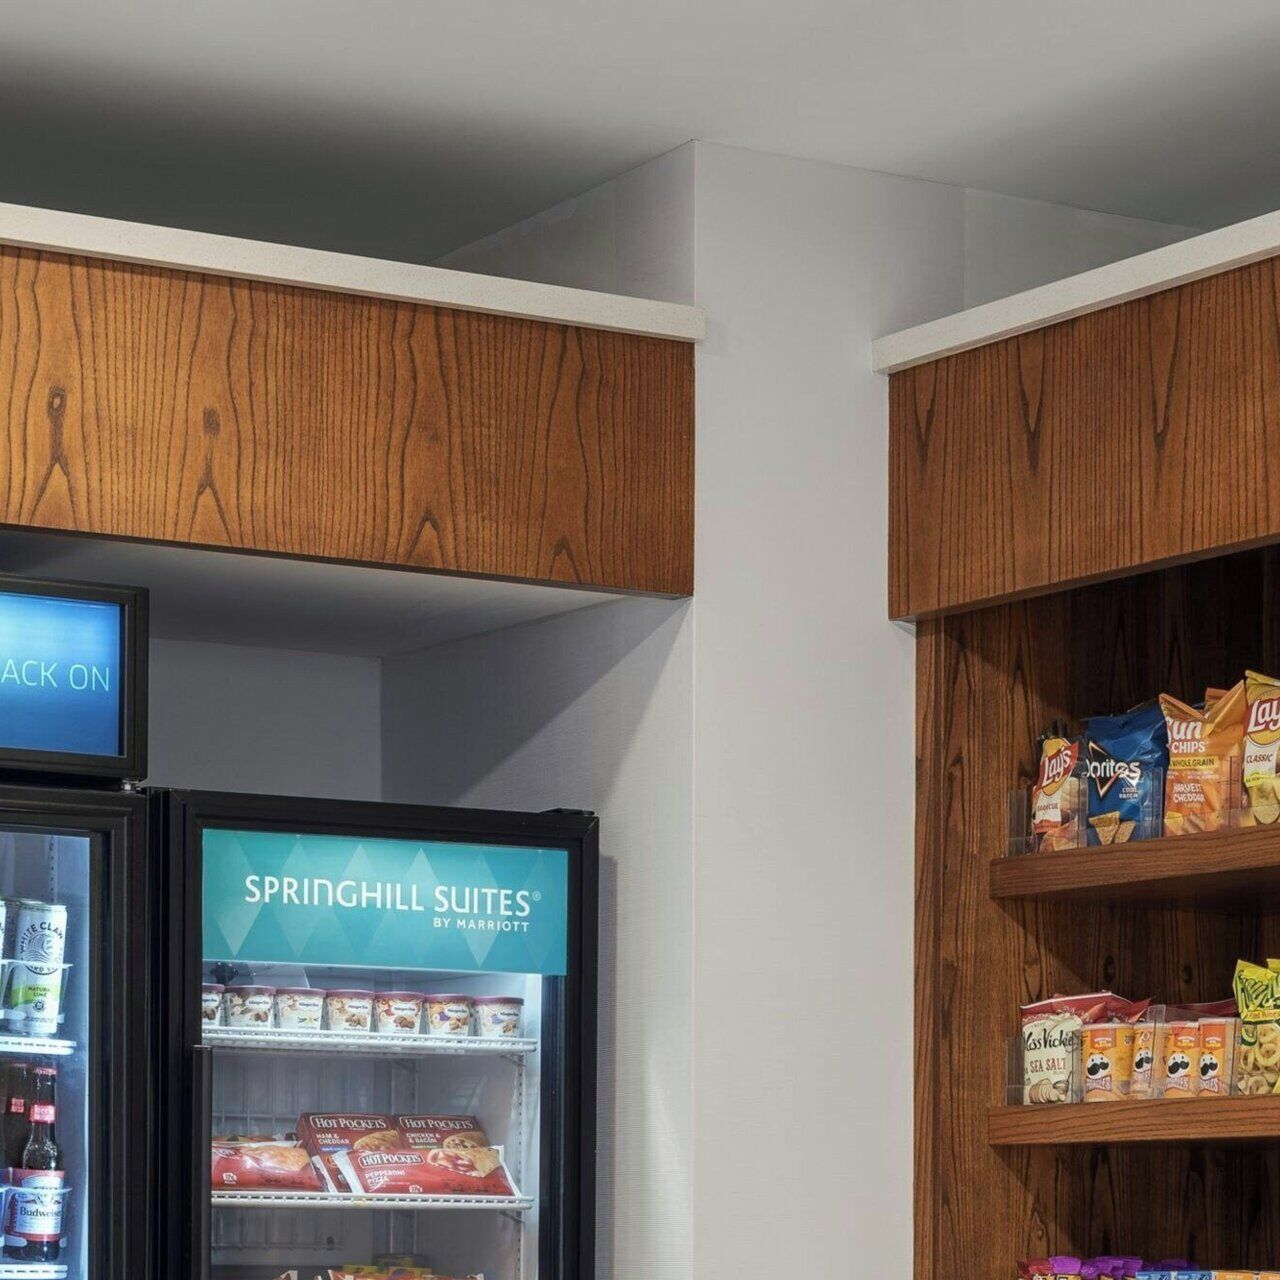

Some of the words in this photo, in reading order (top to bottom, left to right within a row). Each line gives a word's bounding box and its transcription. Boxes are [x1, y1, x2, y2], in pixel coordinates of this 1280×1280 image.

[68, 663, 111, 692] ON
[1171, 741, 1206, 753] CHIPS
[1193, 758, 1215, 766] GRAIN
[1246, 753, 1273, 764] CLASSIC
[1041, 747, 1072, 787] Lay's
[245, 875, 424, 911] SPRINGHILL
[433, 886, 530, 917] SUITES
[433, 917, 451, 928] BY
[456, 919, 530, 932] MARRIOTT
[1030, 1060, 1044, 1073] SEA
[1046, 1058, 1067, 1071] SALT
[316, 1117, 338, 1128] HOT
[339, 1118, 386, 1129] POCKETS
[405, 1119, 426, 1128] HOT
[428, 1119, 474, 1128] POCKETS
[362, 1154, 380, 1166] HOT
[382, 1154, 422, 1164] POCKETS
[364, 1170, 405, 1179] PEPPERONI
